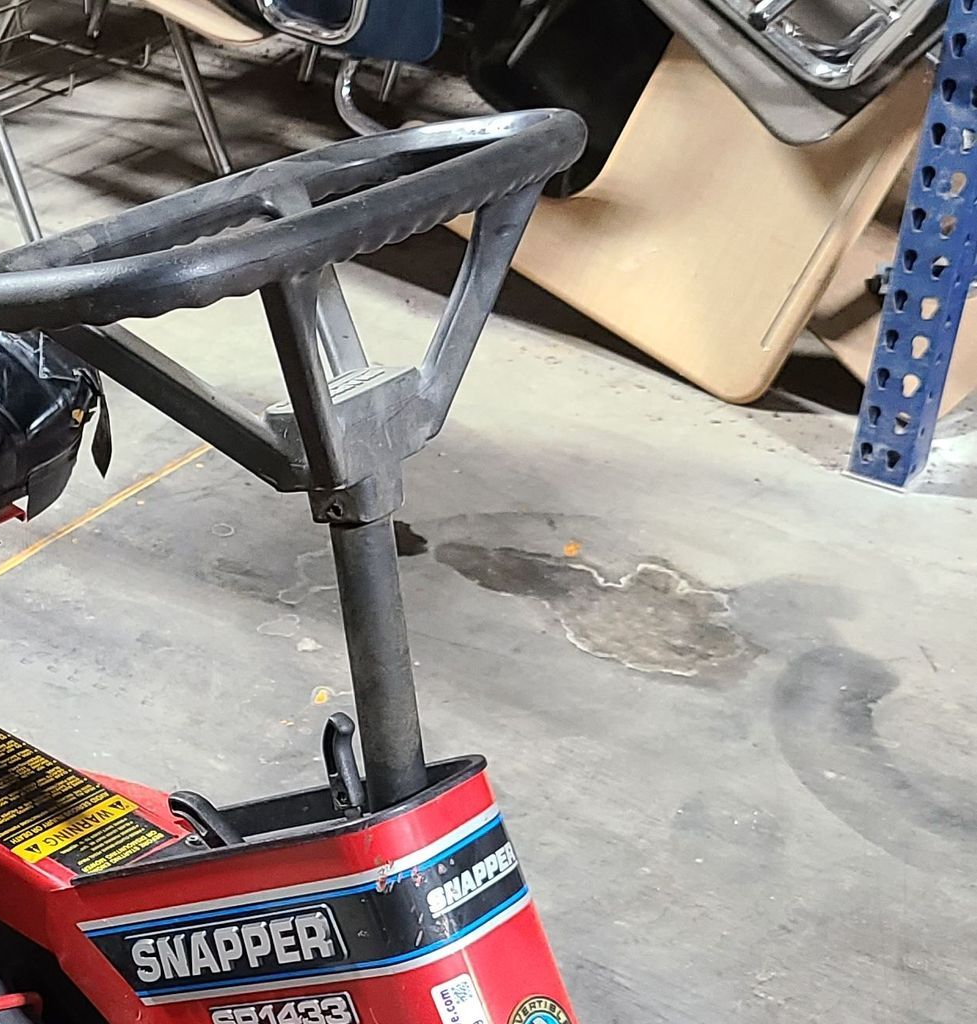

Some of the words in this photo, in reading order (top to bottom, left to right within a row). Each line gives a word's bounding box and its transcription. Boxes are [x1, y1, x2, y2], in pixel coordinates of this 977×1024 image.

[42, 809, 114, 847] WARNING
[426, 841, 517, 912] SNAPPER
[131, 911, 334, 983] SNAPPER
